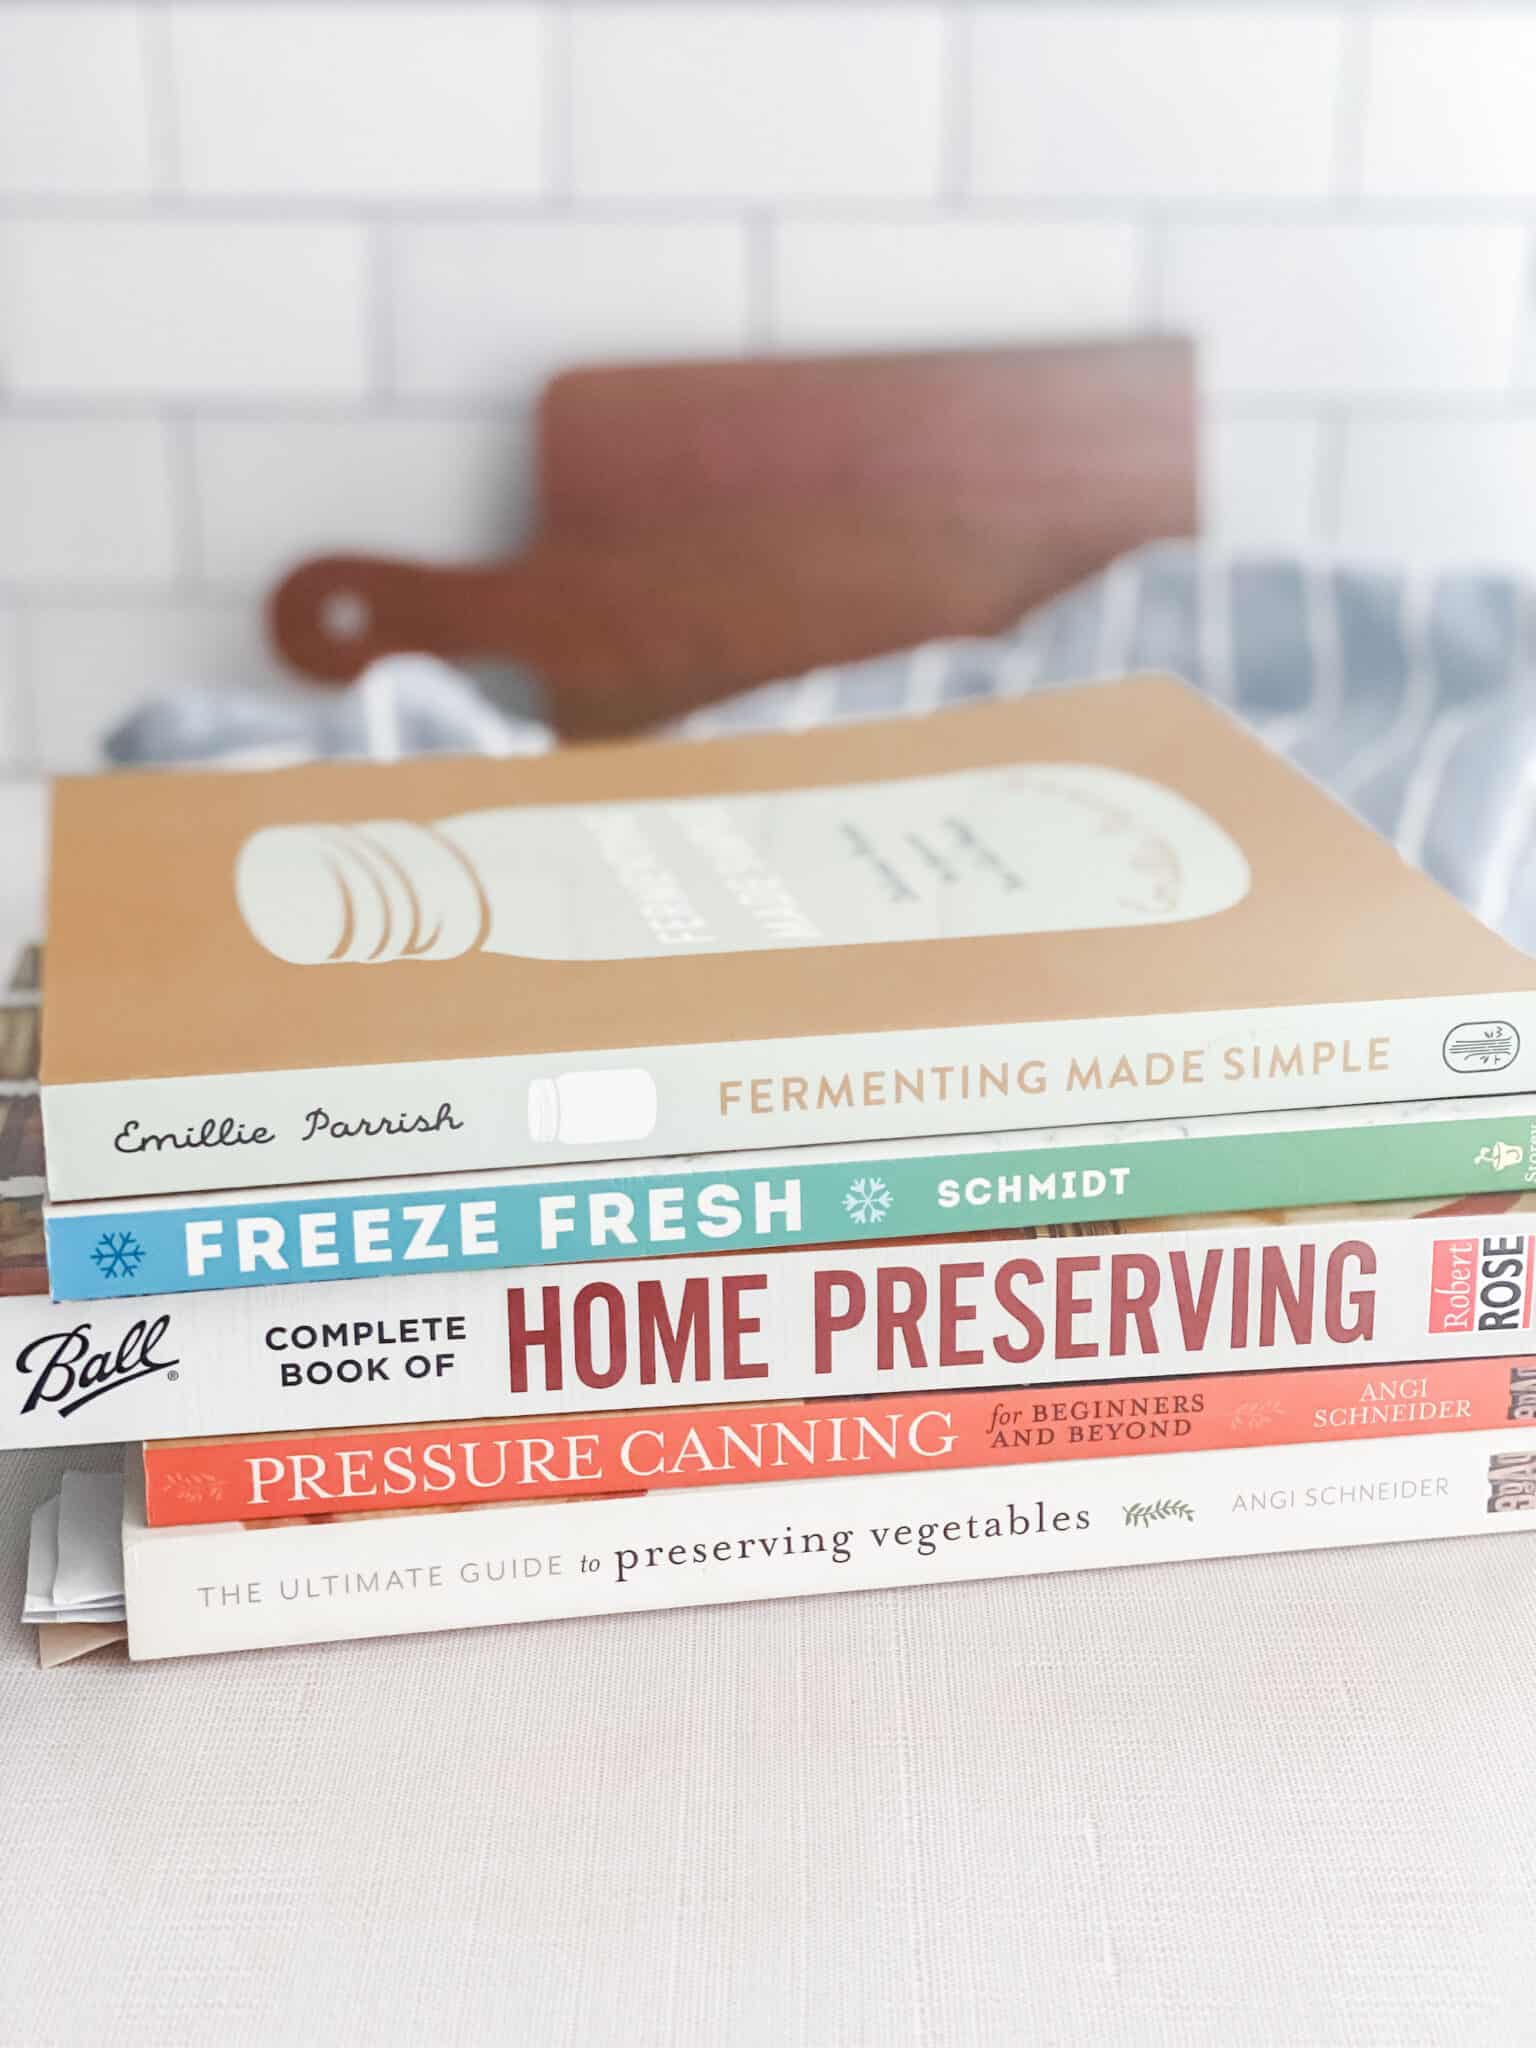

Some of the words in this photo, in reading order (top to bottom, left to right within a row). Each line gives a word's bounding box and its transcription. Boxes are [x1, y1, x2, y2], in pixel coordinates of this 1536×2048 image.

[720, 1061, 1046, 1115] FERMENTING
[1066, 1047, 1204, 1093] MADE
[1224, 1038, 1389, 1080] SIMPLE
[114, 1118, 275, 1153] Emillie
[302, 1103, 464, 1141] Parrish
[938, 1168, 1130, 1207] SCHMIDT
[186, 1201, 498, 1276] FREEZE
[540, 1179, 801, 1249] FRESH
[1434, 1242, 1472, 1329] Robert
[1478, 1236, 1523, 1331] ROSE
[266, 1317, 465, 1350] COMPLETE
[507, 1274, 768, 1393] HOME
[814, 1241, 1376, 1374] PRESERVING
[16, 1315, 180, 1418] Ball
[281, 1358, 389, 1386] BOOK
[405, 1354, 454, 1378] OF
[1360, 1378, 1426, 1401] ANGI
[986, 1404, 1022, 1434] for
[1032, 1394, 1204, 1422] BEGINNERS
[987, 1428, 1054, 1448] AND
[1069, 1419, 1191, 1443] BEYOND
[1314, 1400, 1471, 1427] SCHNEIDER
[246, 1435, 602, 1503] PRESSURE
[621, 1411, 958, 1475] CANNING
[1232, 1490, 1294, 1512] ANGI
[1305, 1478, 1448, 1506] SCHNEIDER
[197, 1583, 261, 1607] THE
[280, 1566, 442, 1600] ULTIMATE
[461, 1555, 560, 1583] GUIDE
[581, 1555, 600, 1573] to
[615, 1527, 853, 1582] preserving
[870, 1502, 1089, 1554] vegetables
